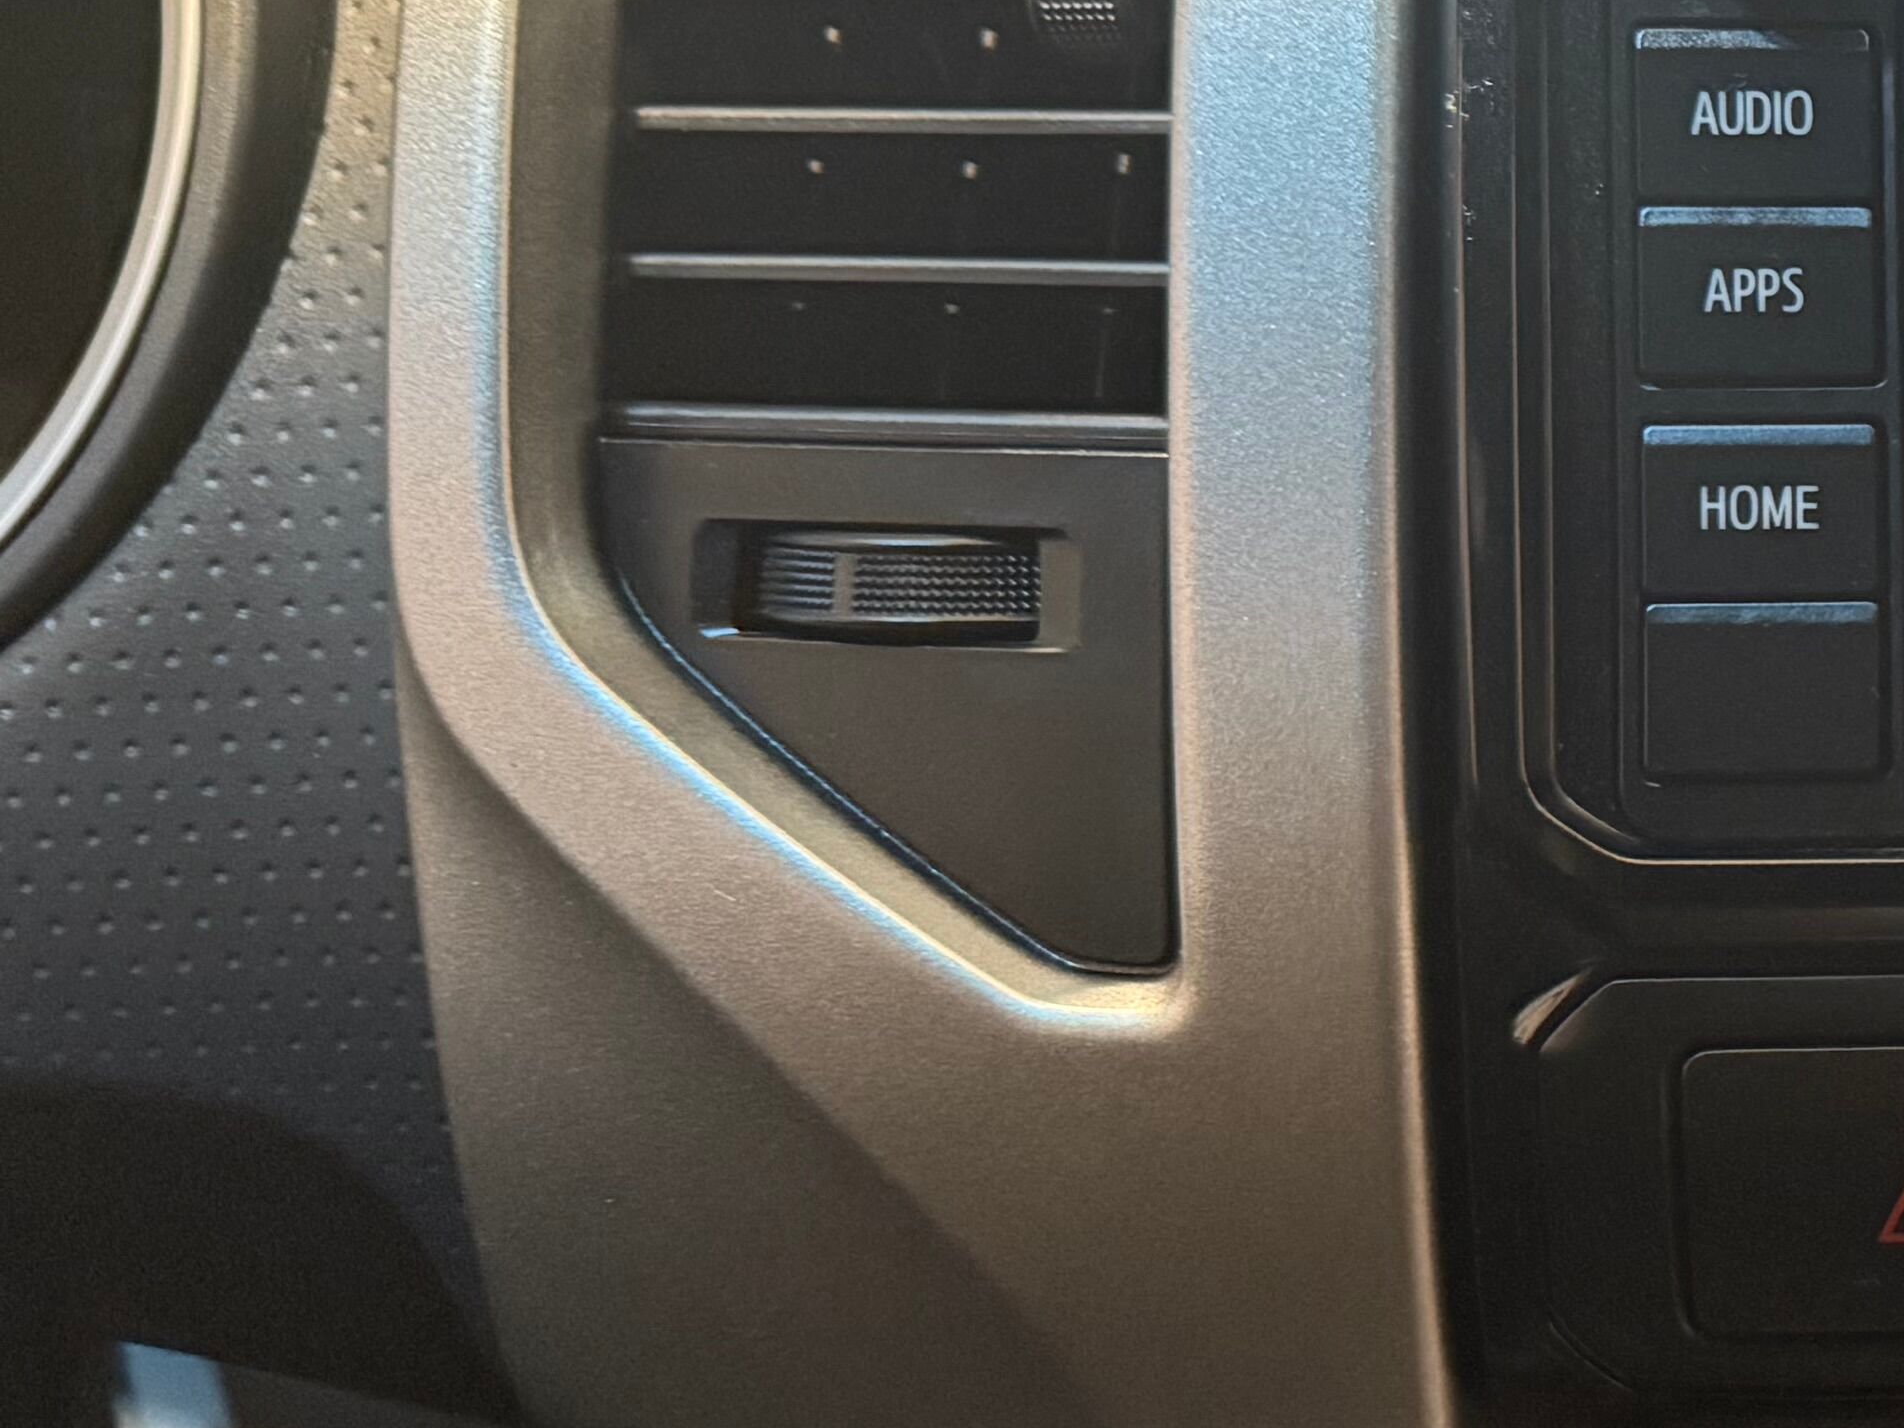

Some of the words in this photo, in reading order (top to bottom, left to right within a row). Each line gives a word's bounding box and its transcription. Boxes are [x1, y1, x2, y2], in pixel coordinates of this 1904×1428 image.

[1690, 89, 1814, 136] AUDIO
[1704, 267, 1804, 313] APPS
[1700, 484, 1819, 531] HOME
